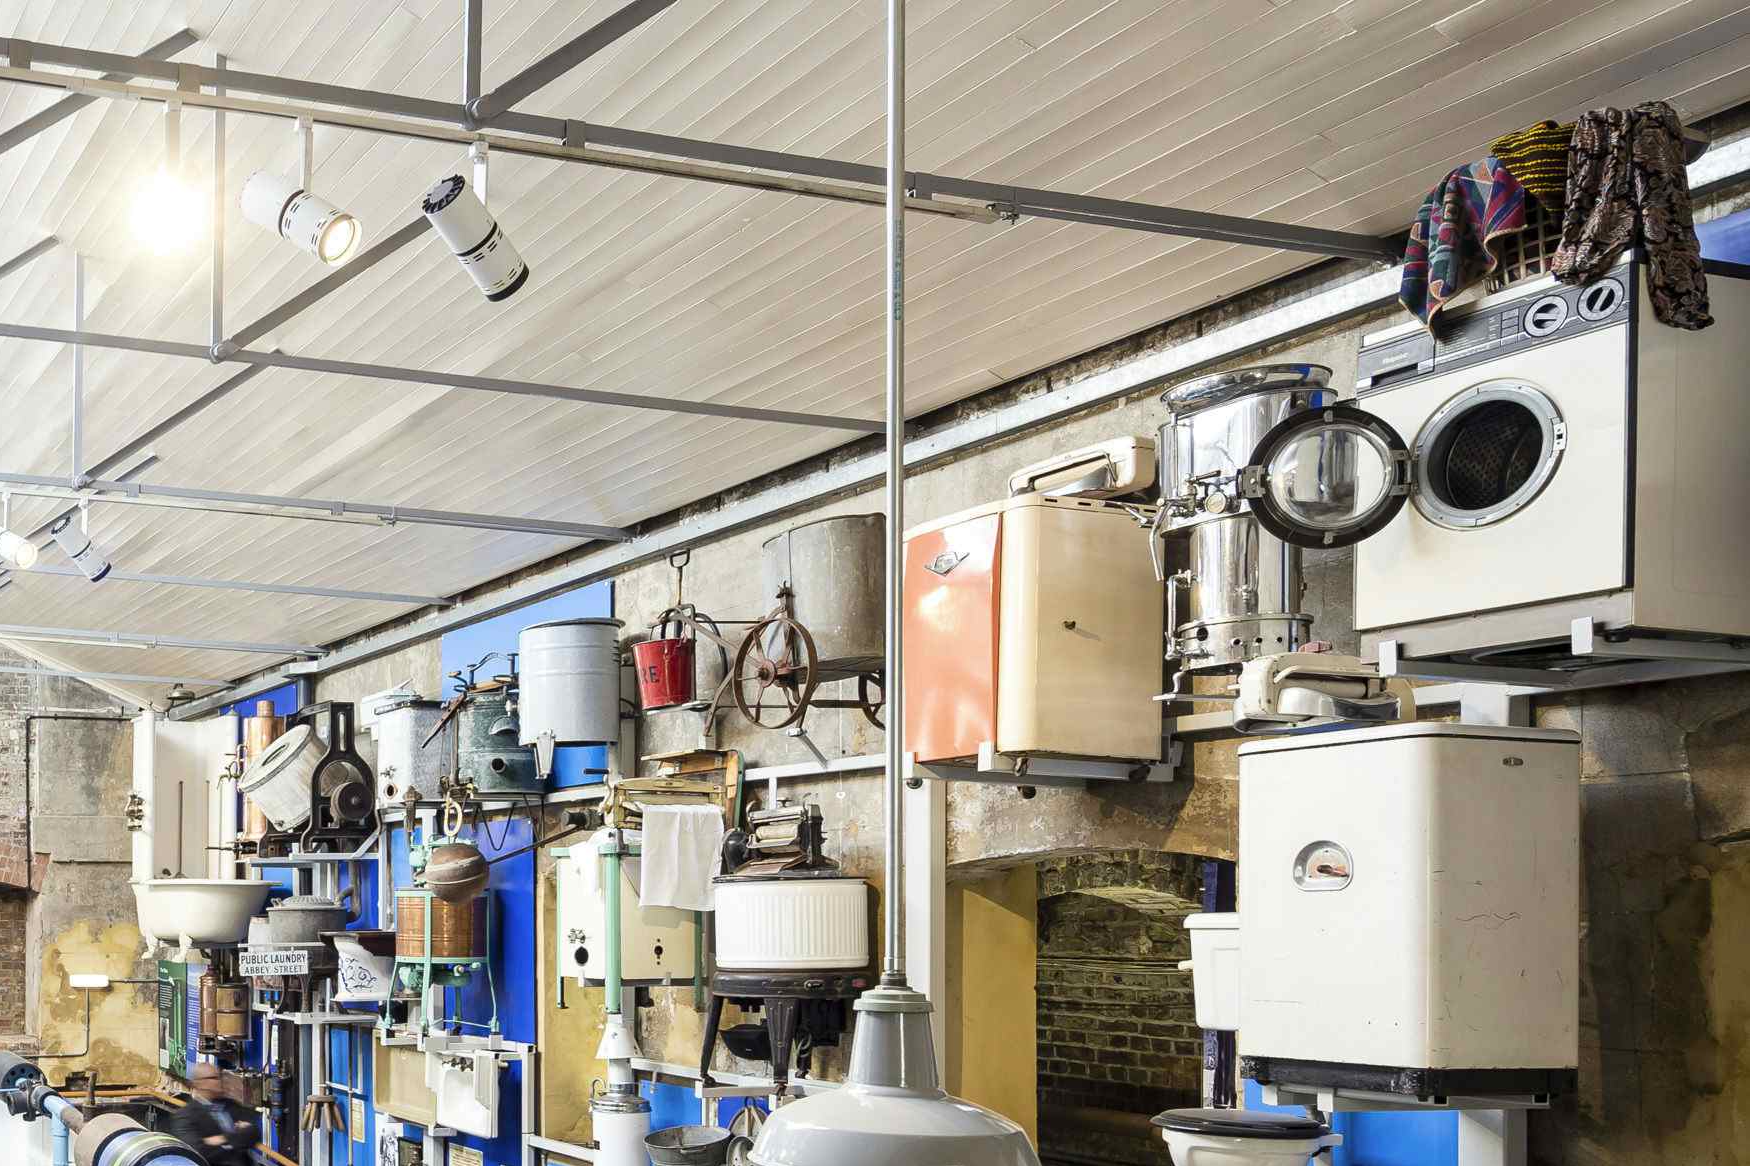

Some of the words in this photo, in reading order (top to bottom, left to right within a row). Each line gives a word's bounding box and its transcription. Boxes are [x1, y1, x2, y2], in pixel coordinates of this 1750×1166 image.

[240, 954, 269, 965] PUBLIC
[270, 953, 307, 964] LAUNDRY
[244, 966, 270, 975] ABBEY
[273, 965, 304, 974] STREET
